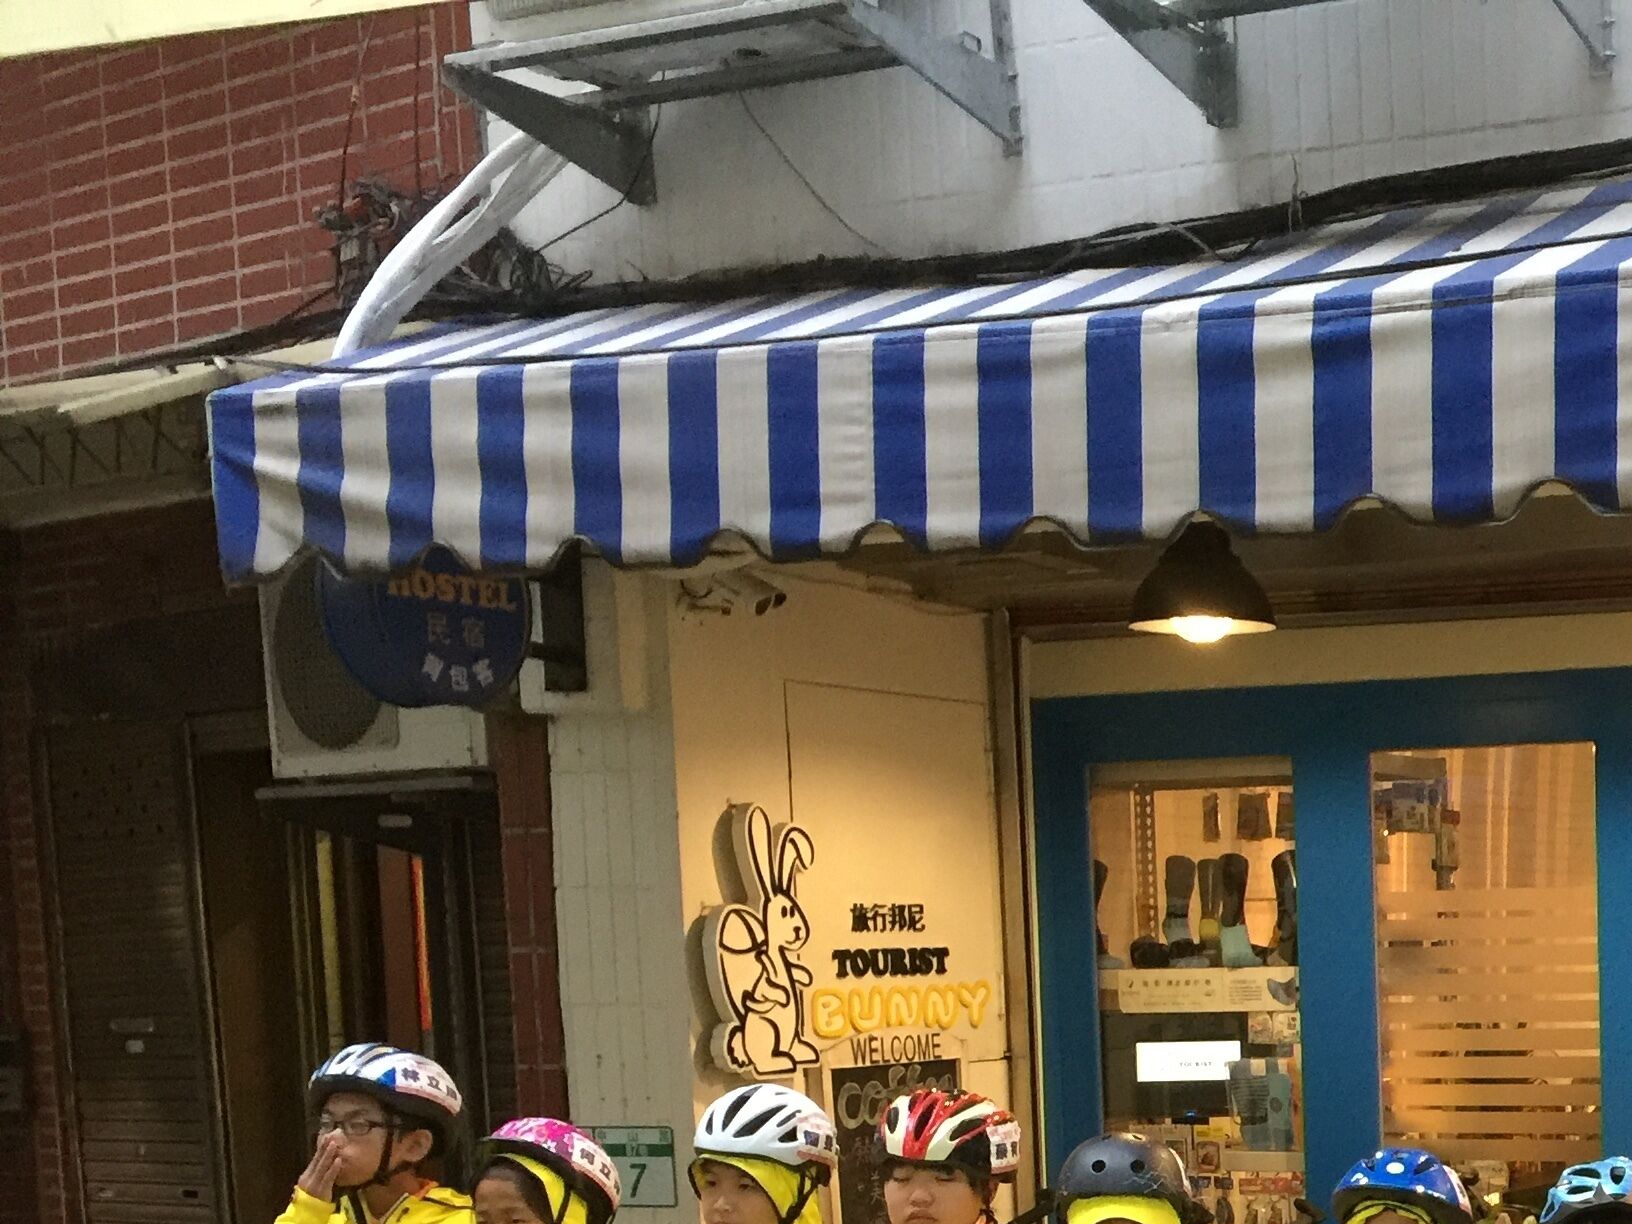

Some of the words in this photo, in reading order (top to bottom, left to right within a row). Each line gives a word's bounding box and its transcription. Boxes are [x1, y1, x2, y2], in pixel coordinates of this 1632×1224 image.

[832, 947, 950, 979] TOURIST
[811, 979, 991, 1039] BUNNY
[851, 1032, 943, 1066] WELCOME
[629, 1163, 647, 1198] 7
